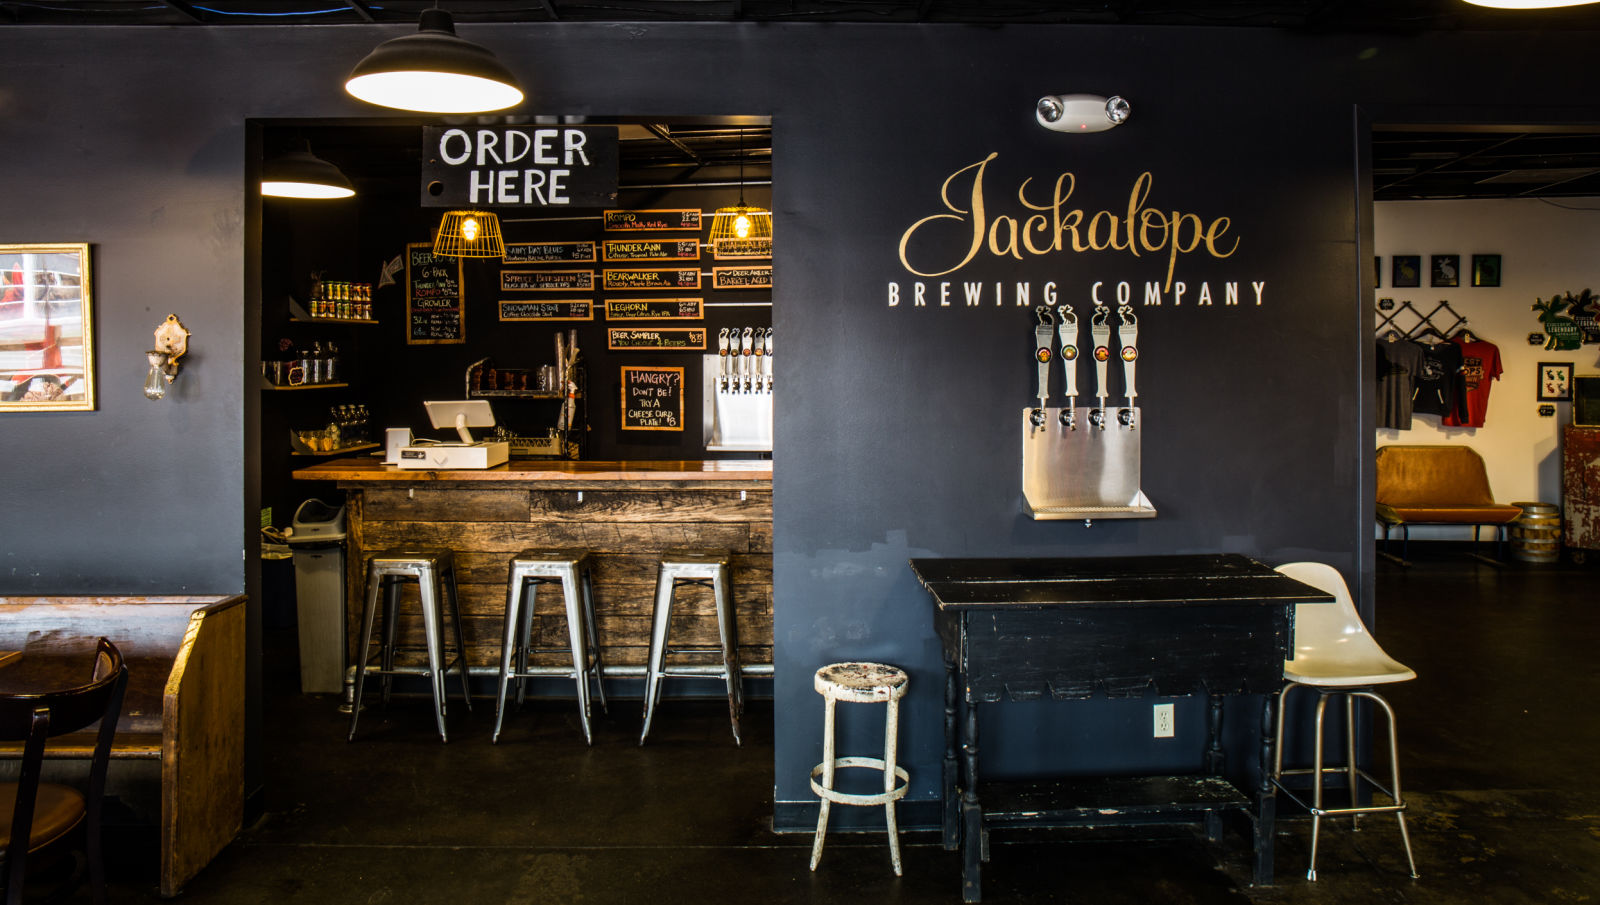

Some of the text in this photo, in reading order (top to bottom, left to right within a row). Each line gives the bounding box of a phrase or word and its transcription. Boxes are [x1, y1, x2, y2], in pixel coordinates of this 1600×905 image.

[439, 129, 590, 165] ORDER
[469, 169, 570, 205] HERE
[899, 152, 1240, 293] Jackalope
[528, 245, 542, 254] DAY
[607, 243, 661, 252] THUNDER ANN
[607, 272, 659, 280] BEARWALKER
[720, 277, 750, 285] BARREL
[888, 282, 1266, 306] BREWING COMPANY
[418, 299, 452, 308] GROWLER
[503, 303, 538, 312] SNOWMAN
[610, 302, 648, 311] LEGHORN
[612, 331, 629, 340] BEER
[630, 331, 660, 340] SAMPLER
[631, 371, 680, 386] HANGRY?
[657, 386, 672, 397] BE!
[639, 398, 660, 408] TRY A
[628, 409, 673, 418] CHEESE CURD
